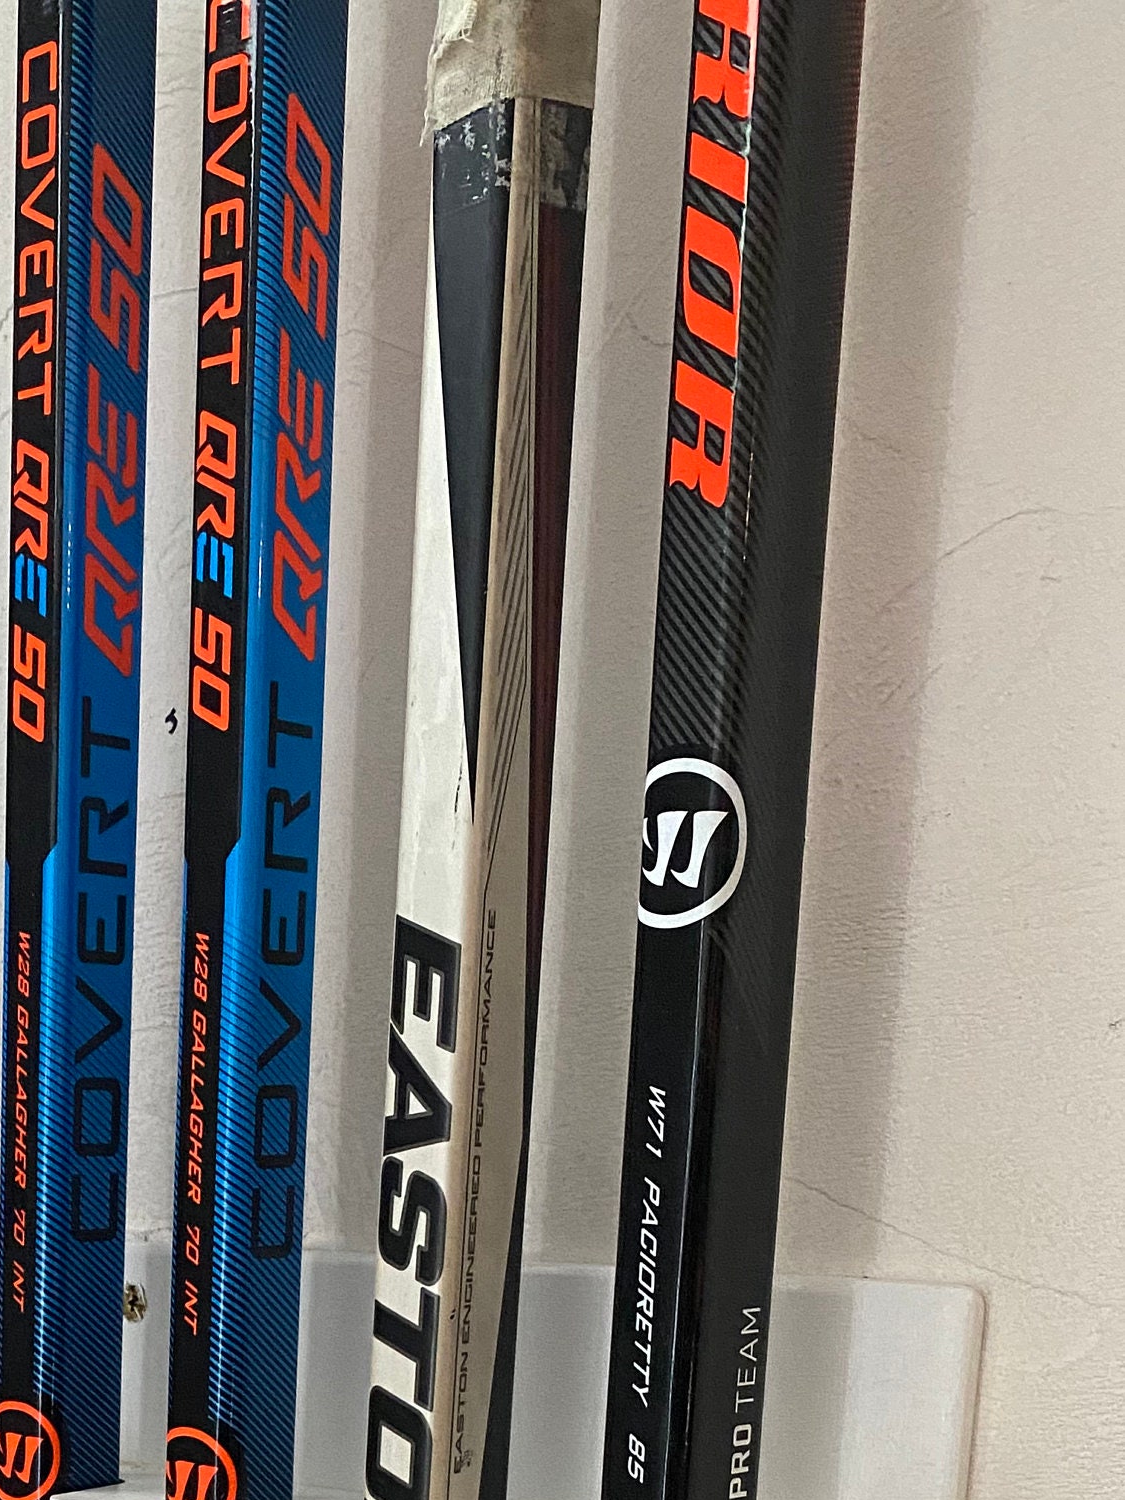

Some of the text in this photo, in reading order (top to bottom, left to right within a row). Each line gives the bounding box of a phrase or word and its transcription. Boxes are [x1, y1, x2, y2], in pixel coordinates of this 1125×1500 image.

[13, 41, 59, 744] COVERT QRE 50
[192, 0, 251, 733] COVERT QRE 50
[71, 142, 143, 1243] COVERT QRE 50
[248, 92, 332, 1260] COVERT QRE 50
[11, 931, 31, 1313] W28 GALLAGHER 70 INT
[184, 932, 211, 1336] W28 GALLAGHER 70 INT
[474, 909, 497, 1148] PERFORMANCE
[646, 1084, 667, 1159] W71
[461, 1154, 481, 1345] ENGINEERED
[627, 1176, 661, 1408] PACIORETTY
[735, 1306, 762, 1413] TEAM
[454, 1351, 469, 1475] EASTON
[627, 1433, 645, 1484] 85
[728, 1423, 753, 1500] PRO
